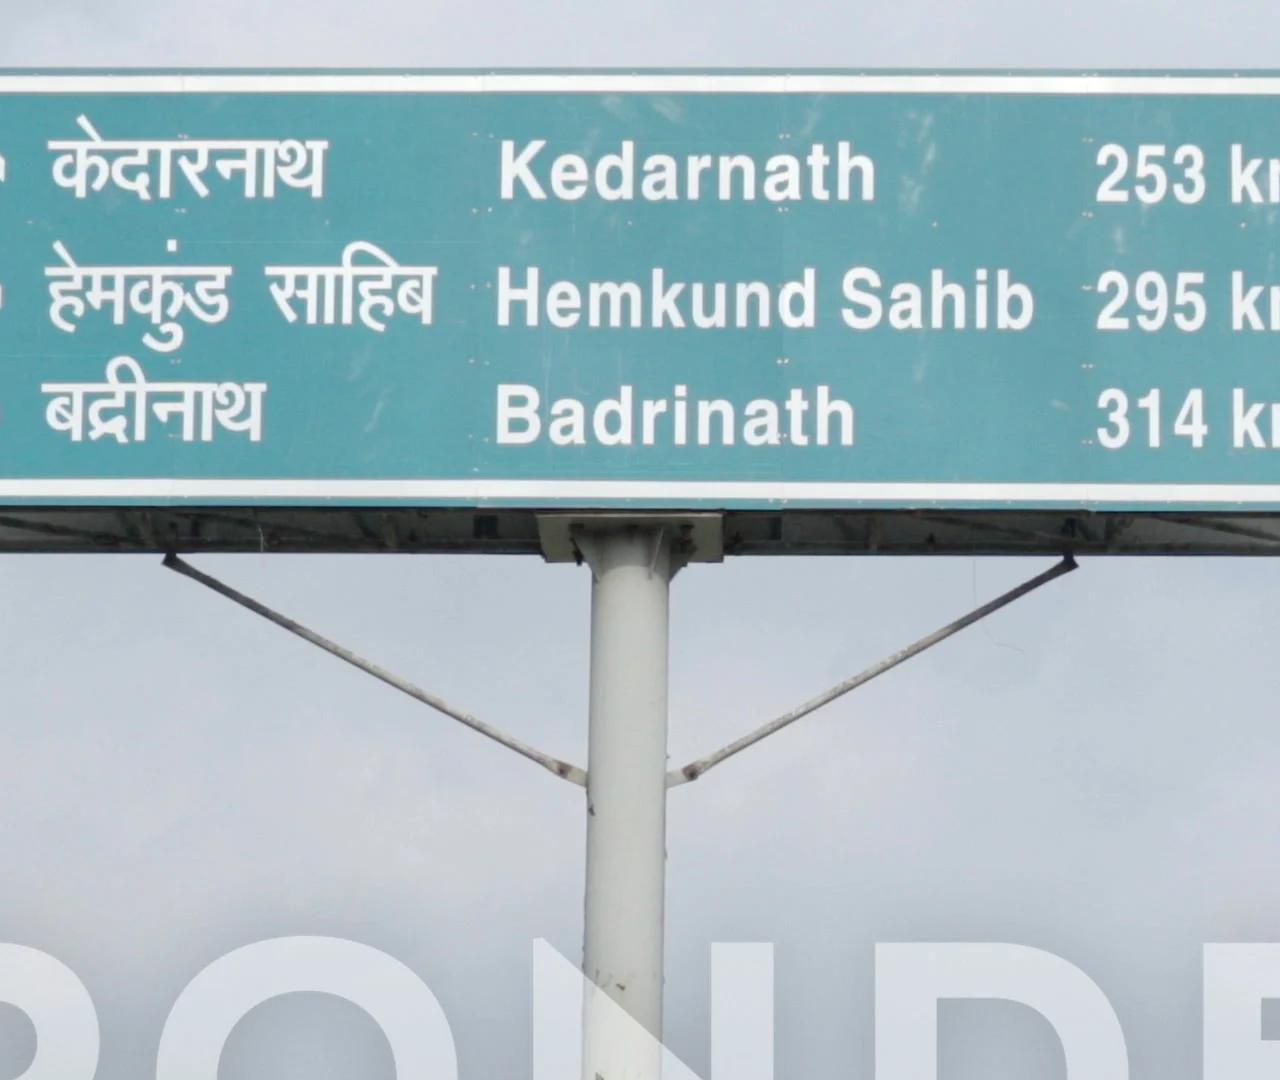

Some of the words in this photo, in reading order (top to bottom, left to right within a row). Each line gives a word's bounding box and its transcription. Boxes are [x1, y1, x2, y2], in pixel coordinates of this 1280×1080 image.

[47, 114, 328, 200] केदारनाथ
[500, 139, 876, 201] Kedarnath
[1096, 143, 1207, 204] 253
[44, 239, 233, 353] हेमकुंड
[265, 240, 437, 332] साहिब
[497, 266, 816, 328] Hemkund
[841, 266, 1035, 330] Sahib
[1096, 270, 1207, 332] 295
[41, 355, 267, 444] बद्रीनाथ
[496, 384, 855, 447] Badrinath
[1096, 387, 1208, 448] 314
